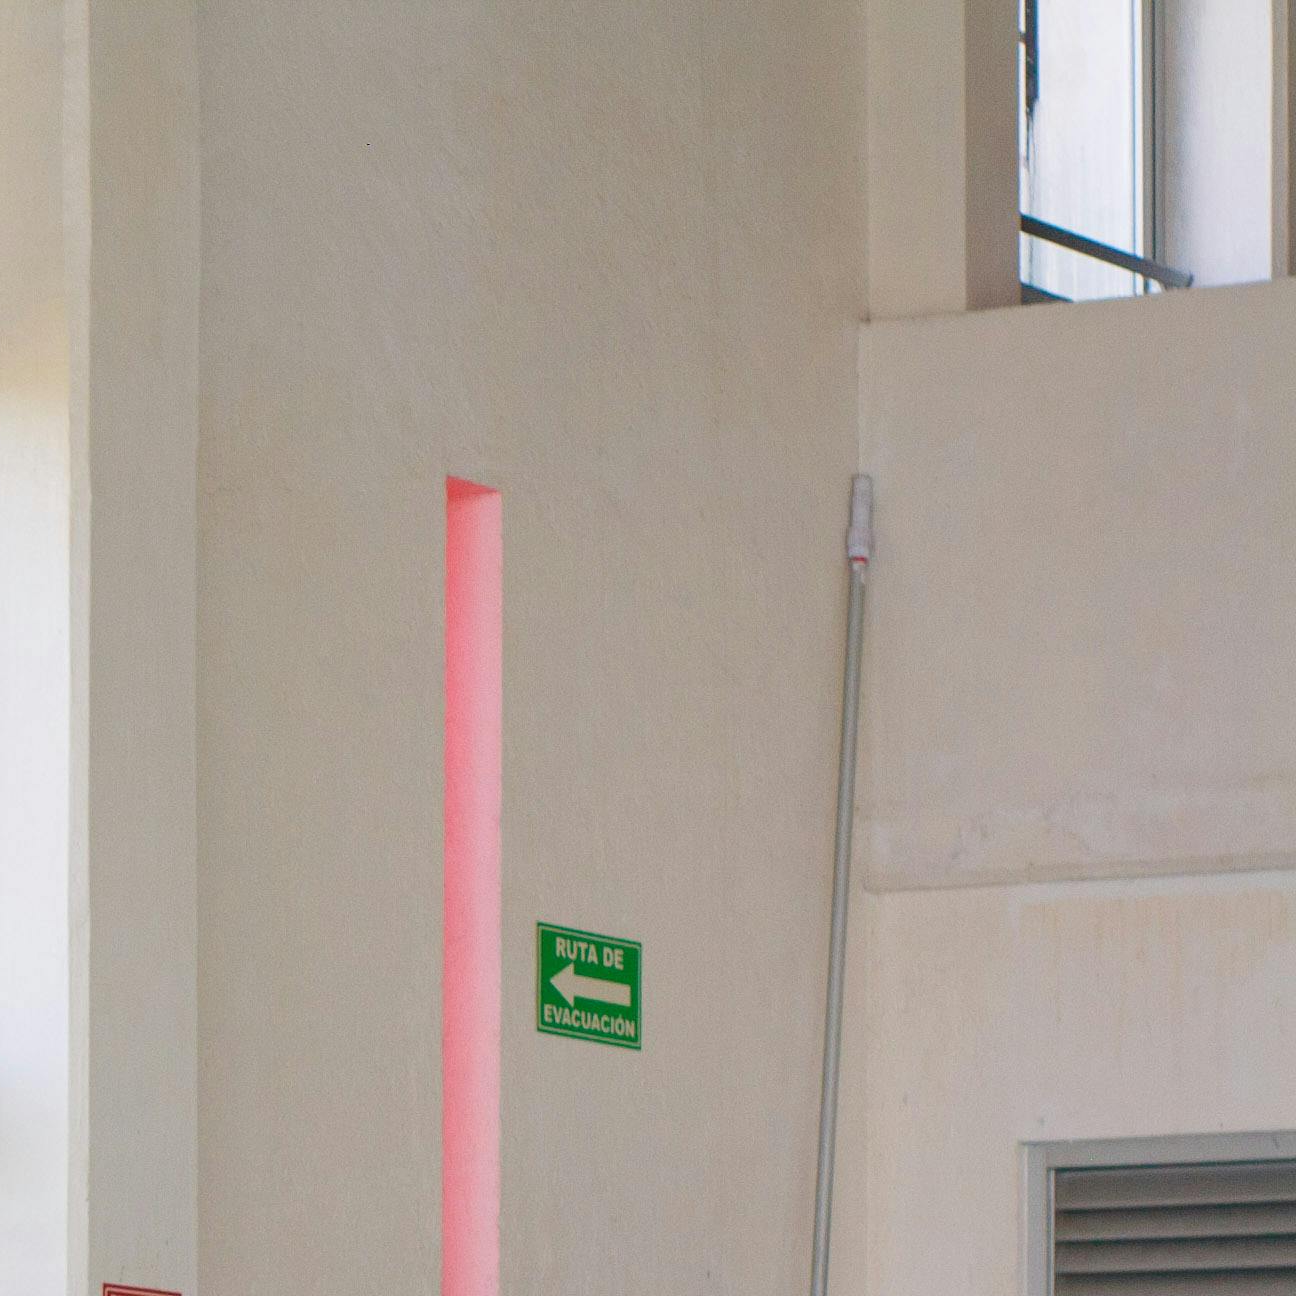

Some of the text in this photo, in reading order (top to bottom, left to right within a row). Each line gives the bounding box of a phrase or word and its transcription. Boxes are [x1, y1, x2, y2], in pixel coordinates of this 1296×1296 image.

[555, 936, 624, 970] RUTA DE
[543, 1004, 636, 1037] EVACUACIÓN
